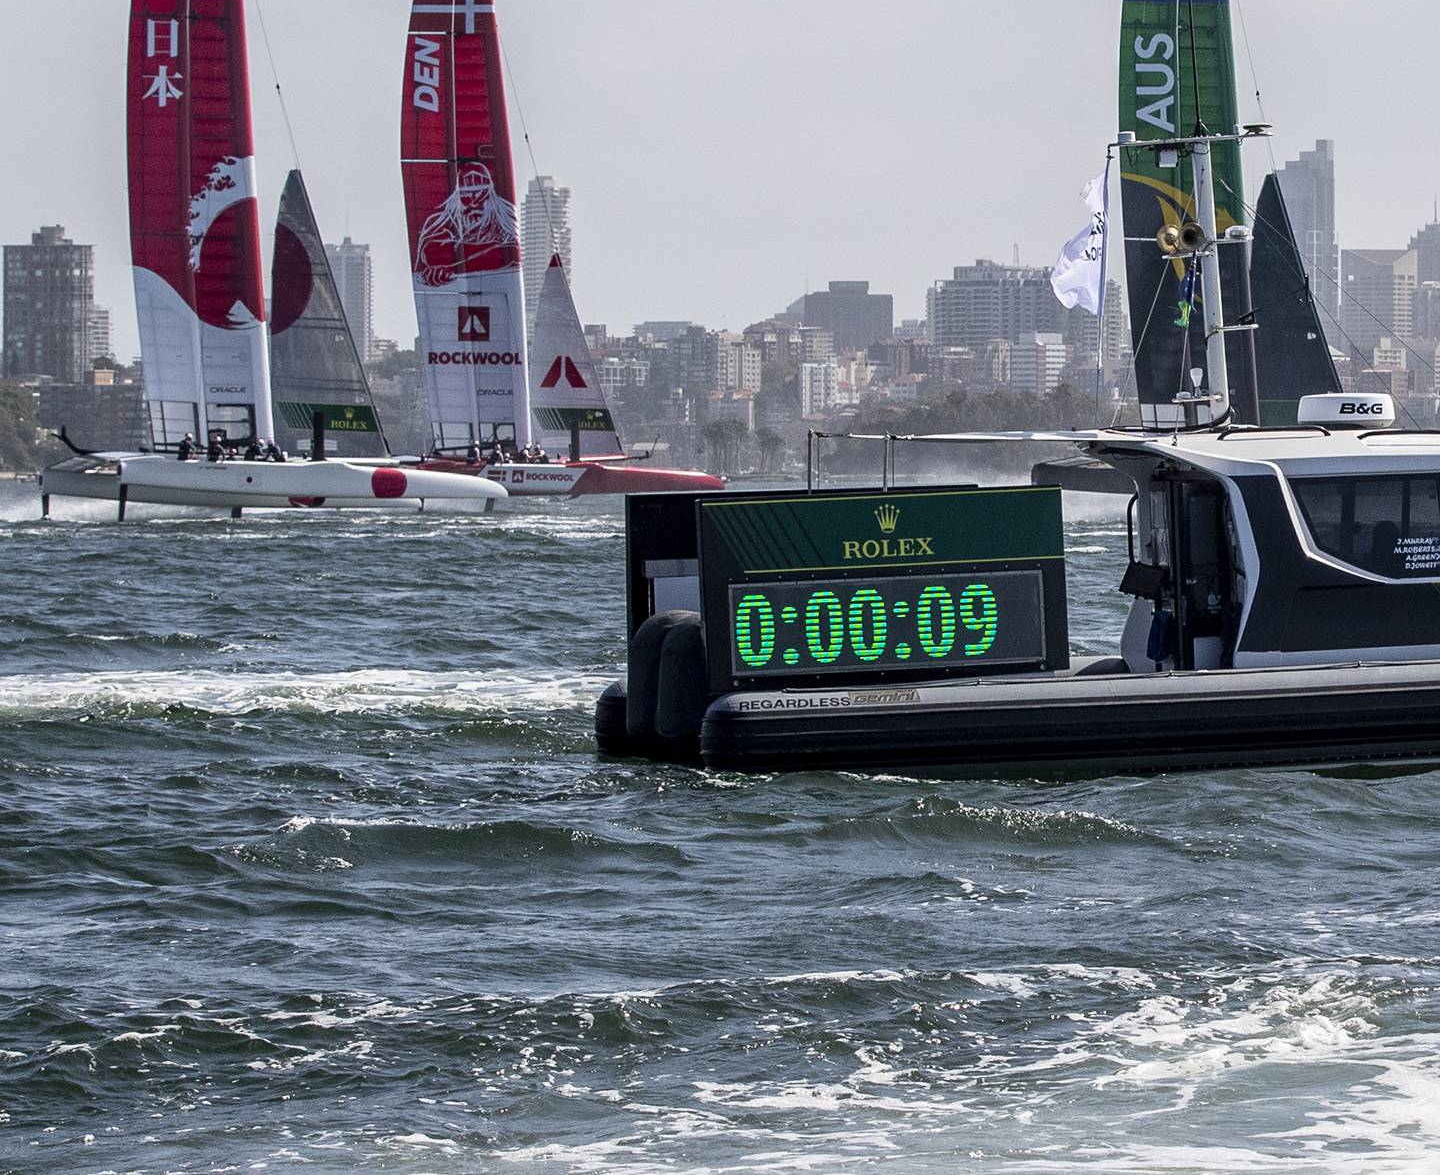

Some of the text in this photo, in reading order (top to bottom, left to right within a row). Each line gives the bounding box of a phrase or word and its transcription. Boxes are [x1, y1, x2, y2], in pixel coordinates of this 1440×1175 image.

[141, 19, 184, 108] 日本
[413, 37, 440, 114] DEN
[1134, 32, 1175, 133] AUS
[428, 352, 522, 365] ROCKWOOL
[209, 386, 247, 394] ORACLE
[1339, 402, 1384, 415] B&G
[330, 420, 368, 430] ROLEX
[526, 473, 575, 482] ROCKWOOL
[842, 537, 936, 559] ROLEX
[736, 583, 998, 667] 0:00:09
[739, 696, 851, 712] REGARDLESS
